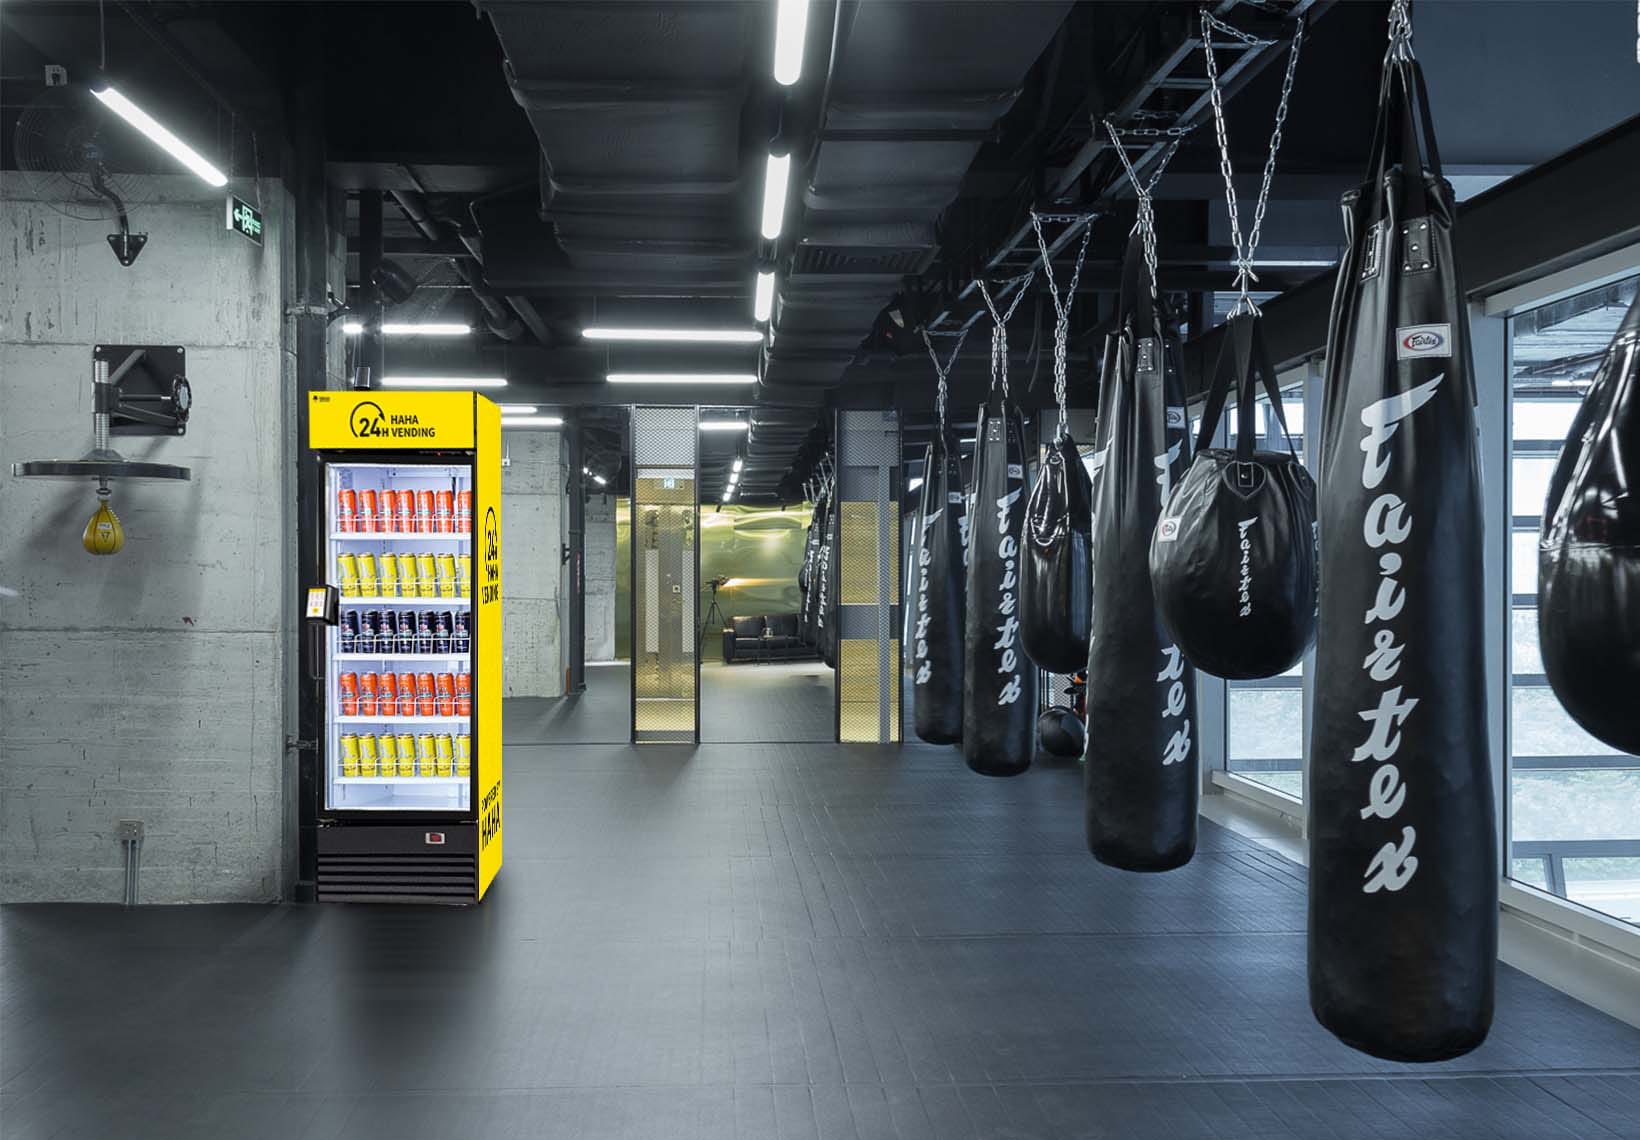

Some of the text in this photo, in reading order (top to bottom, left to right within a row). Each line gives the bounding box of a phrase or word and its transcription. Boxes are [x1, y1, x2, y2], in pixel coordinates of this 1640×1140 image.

[390, 415, 419, 424] HAHA
[391, 428, 435, 437] VENDING
[482, 801, 501, 851] HAHA
